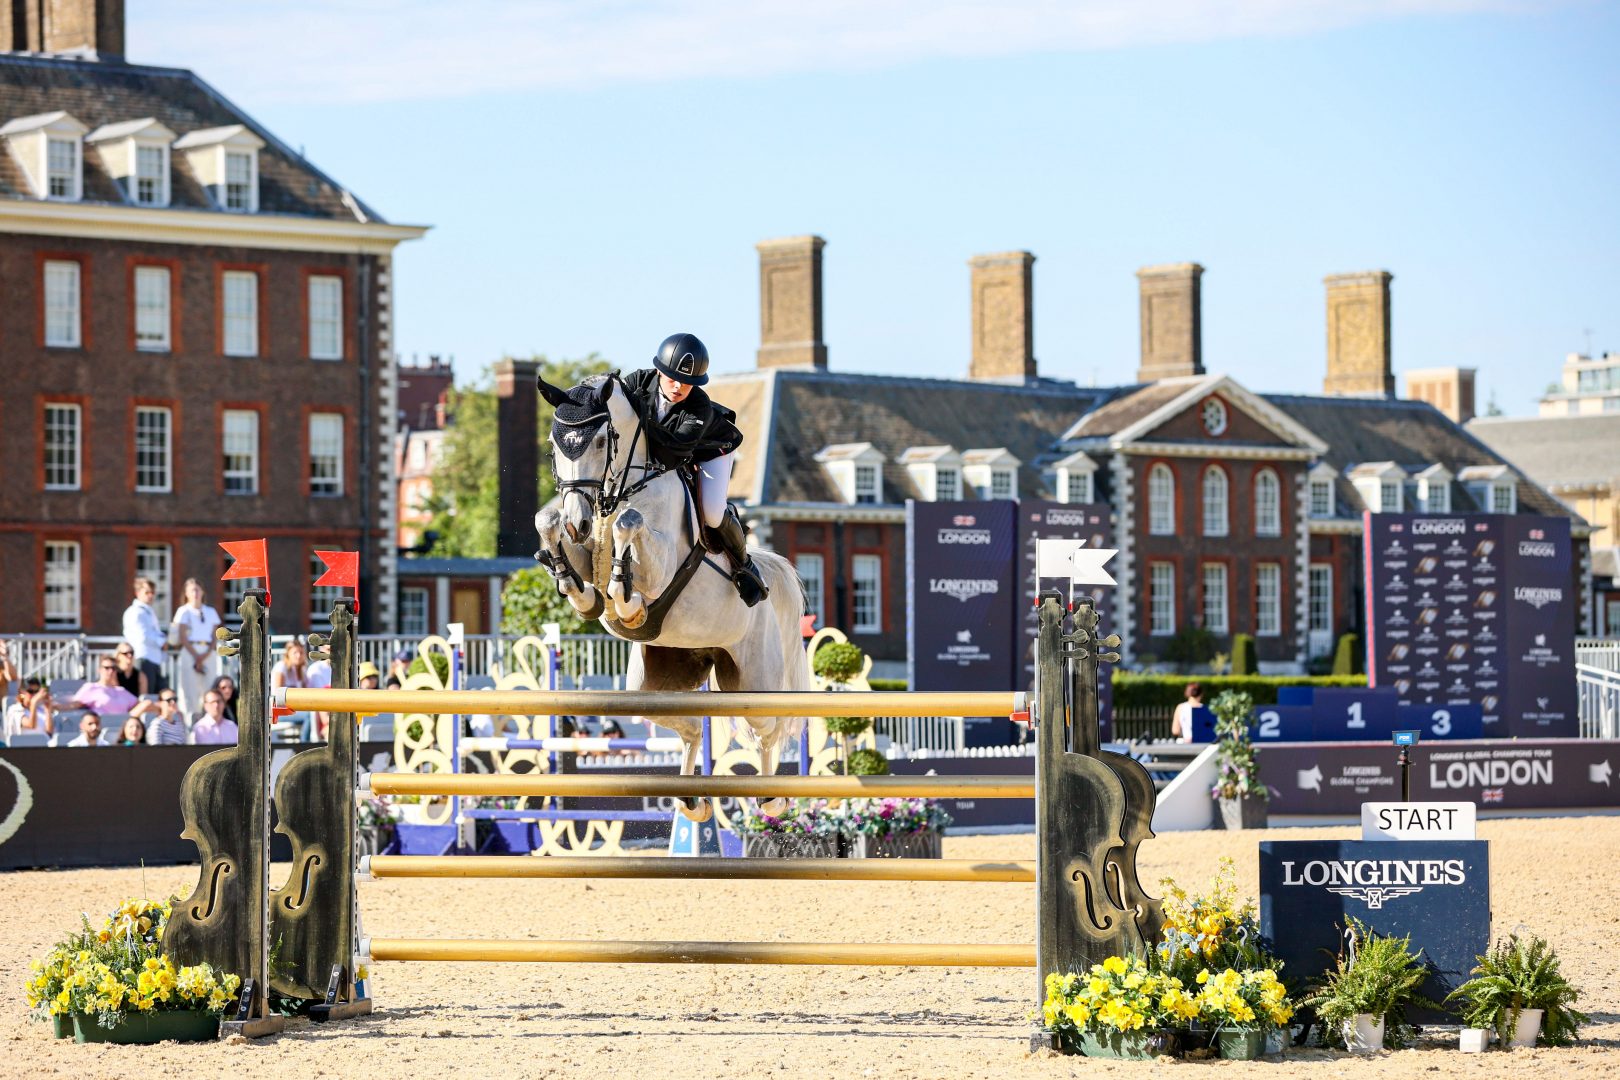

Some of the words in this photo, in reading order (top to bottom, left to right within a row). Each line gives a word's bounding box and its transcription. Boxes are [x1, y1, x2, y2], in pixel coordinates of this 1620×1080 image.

[937, 533, 991, 544] LONDON
[1412, 523, 1466, 535] LONDON
[930, 578, 998, 593] LONGINES
[1259, 711, 1281, 738] 2
[1346, 702, 1366, 728] 1
[1431, 710, 1452, 736] 3
[1330, 777, 1355, 786] GLOBAL
[1356, 776, 1394, 786] CHAMPIONS
[1429, 759, 1553, 789] LONDON
[1378, 808, 1458, 831] START
[680, 827, 689, 842] 9
[703, 827, 713, 842] 9
[1281, 859, 1466, 886] LONGINES
